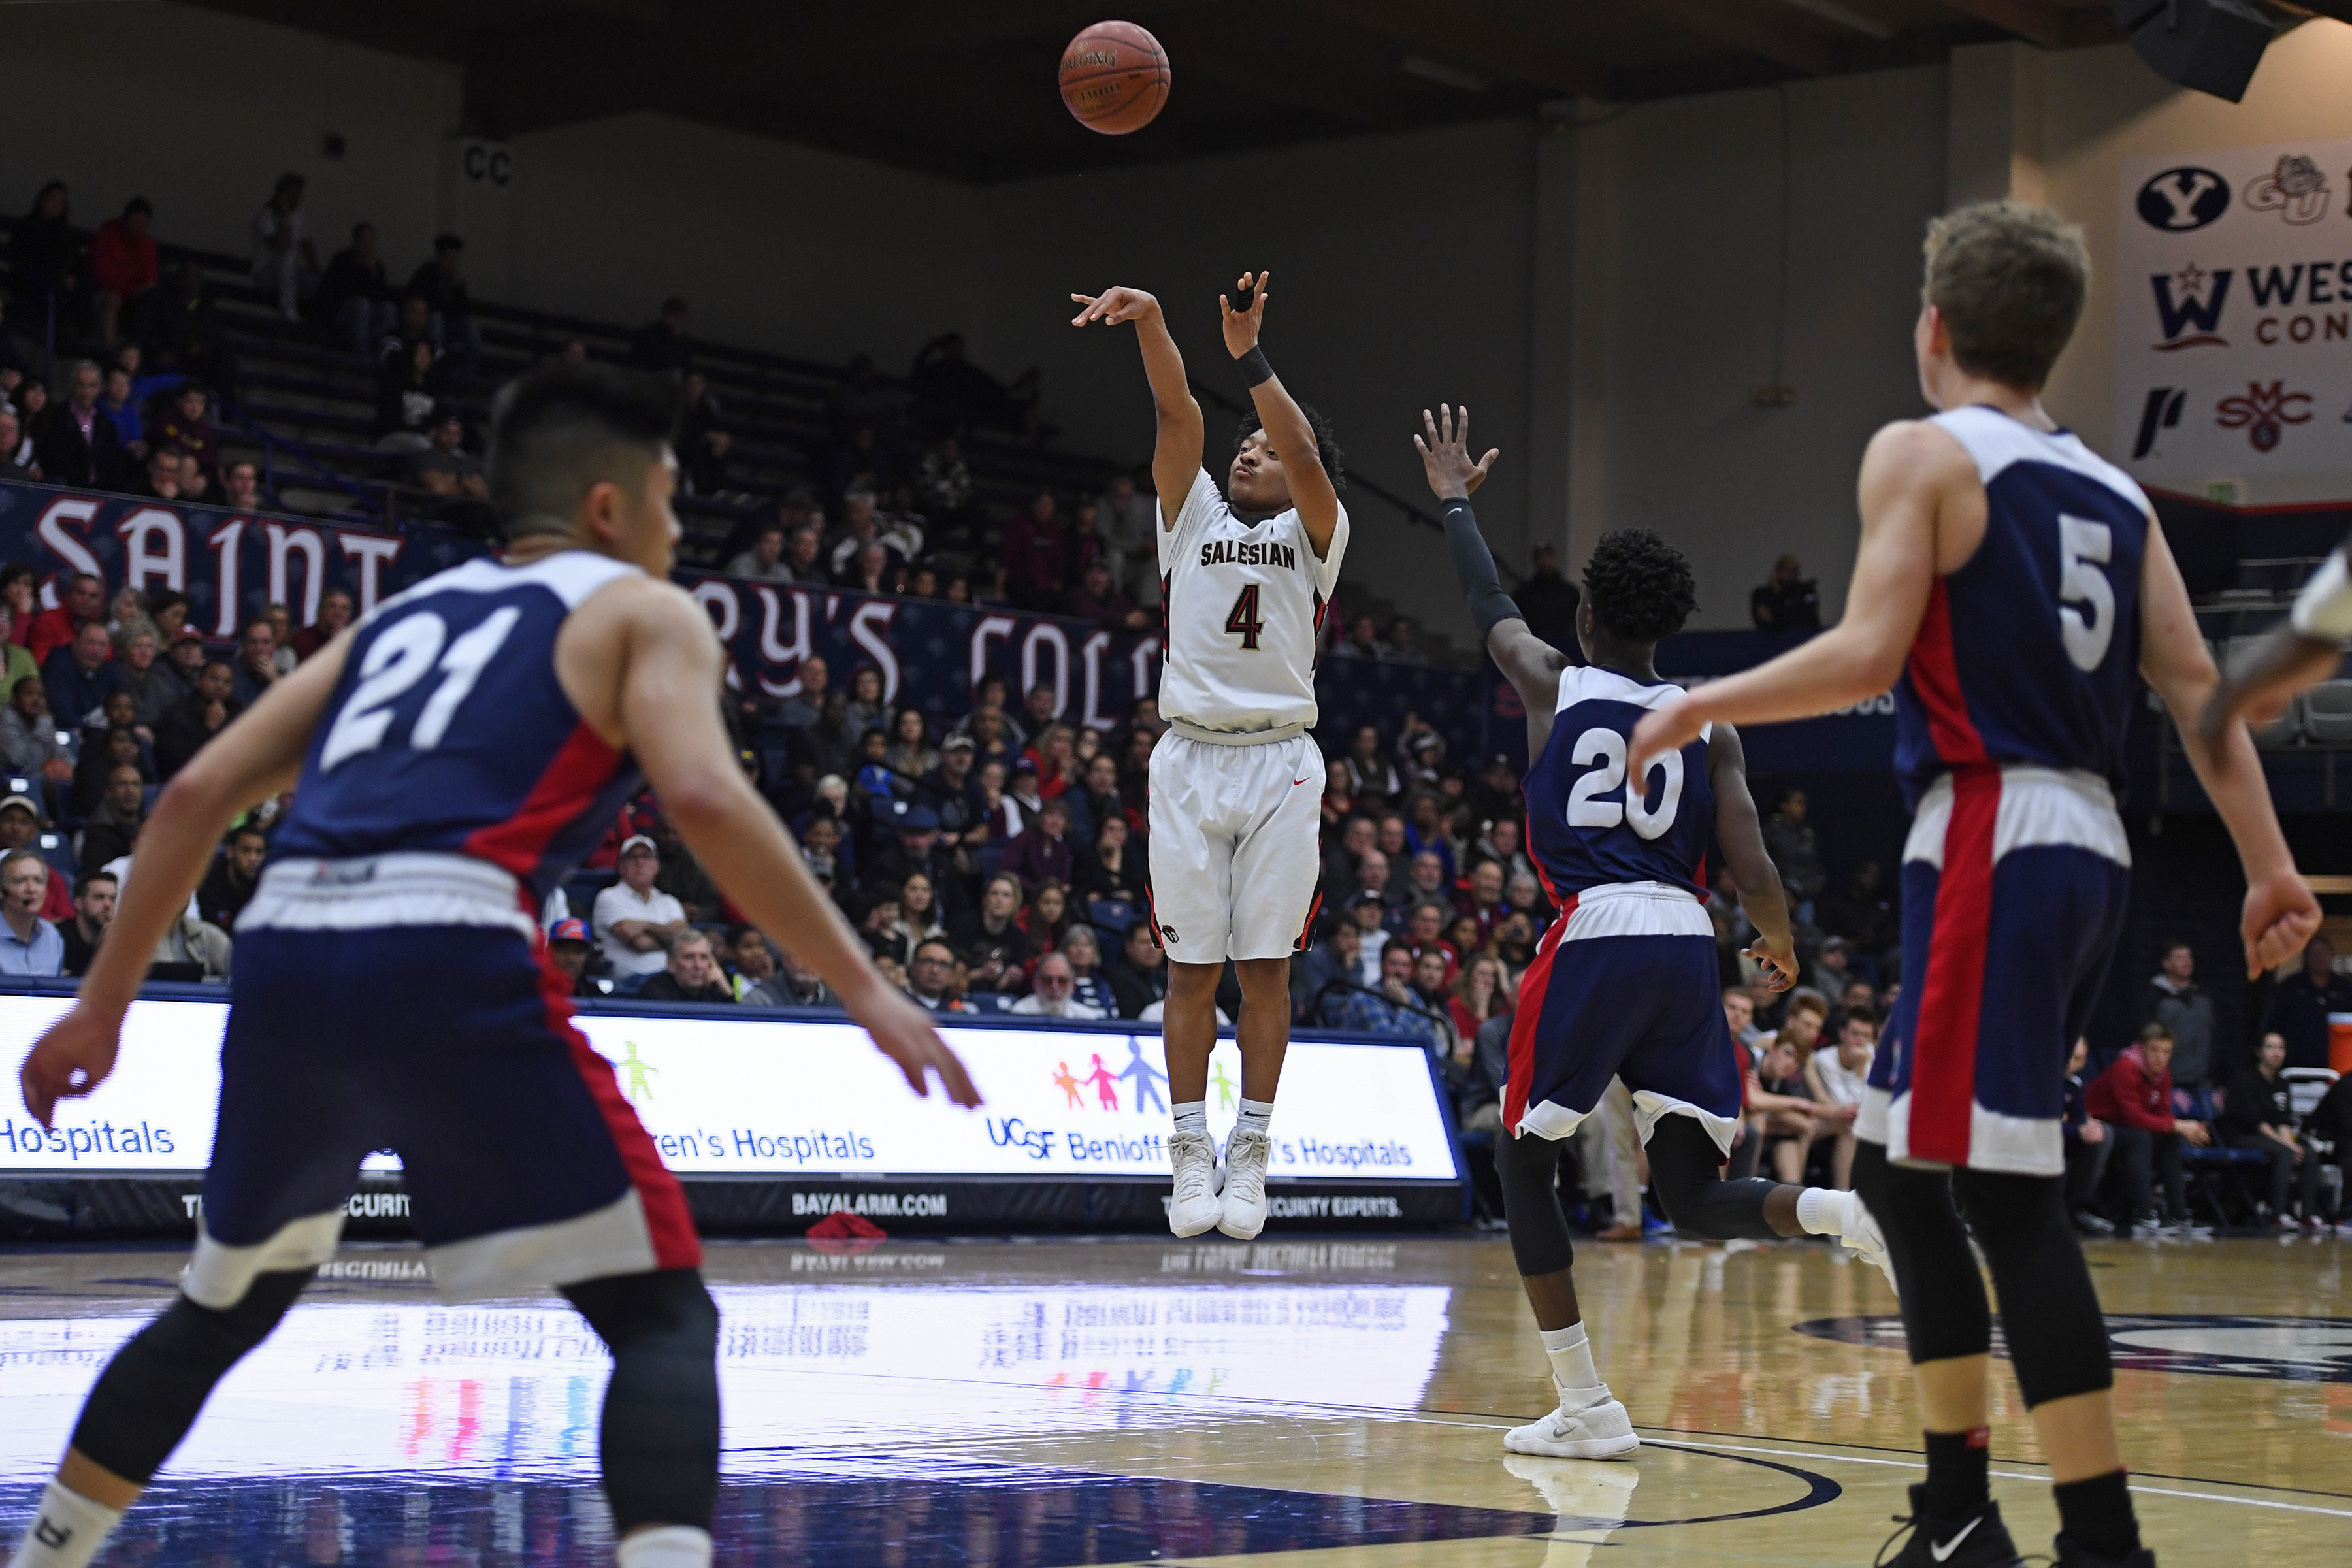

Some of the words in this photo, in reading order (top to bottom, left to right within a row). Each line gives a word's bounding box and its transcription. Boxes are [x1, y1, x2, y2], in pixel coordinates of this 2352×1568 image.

[465, 145, 512, 186] CC
[1200, 540, 1296, 572] SALESIAN
[1224, 583, 1265, 651] 4
[2058, 513, 2116, 673] 5
[319, 604, 521, 773] 21
[1567, 727, 1684, 840] 20
[731, 1129, 875, 1164] Hospitals
[987, 1117, 1054, 1160] UCSF
[1299, 1139, 1413, 1169] Hospitals
[792, 1193, 947, 1217] BAYALARM.COM
